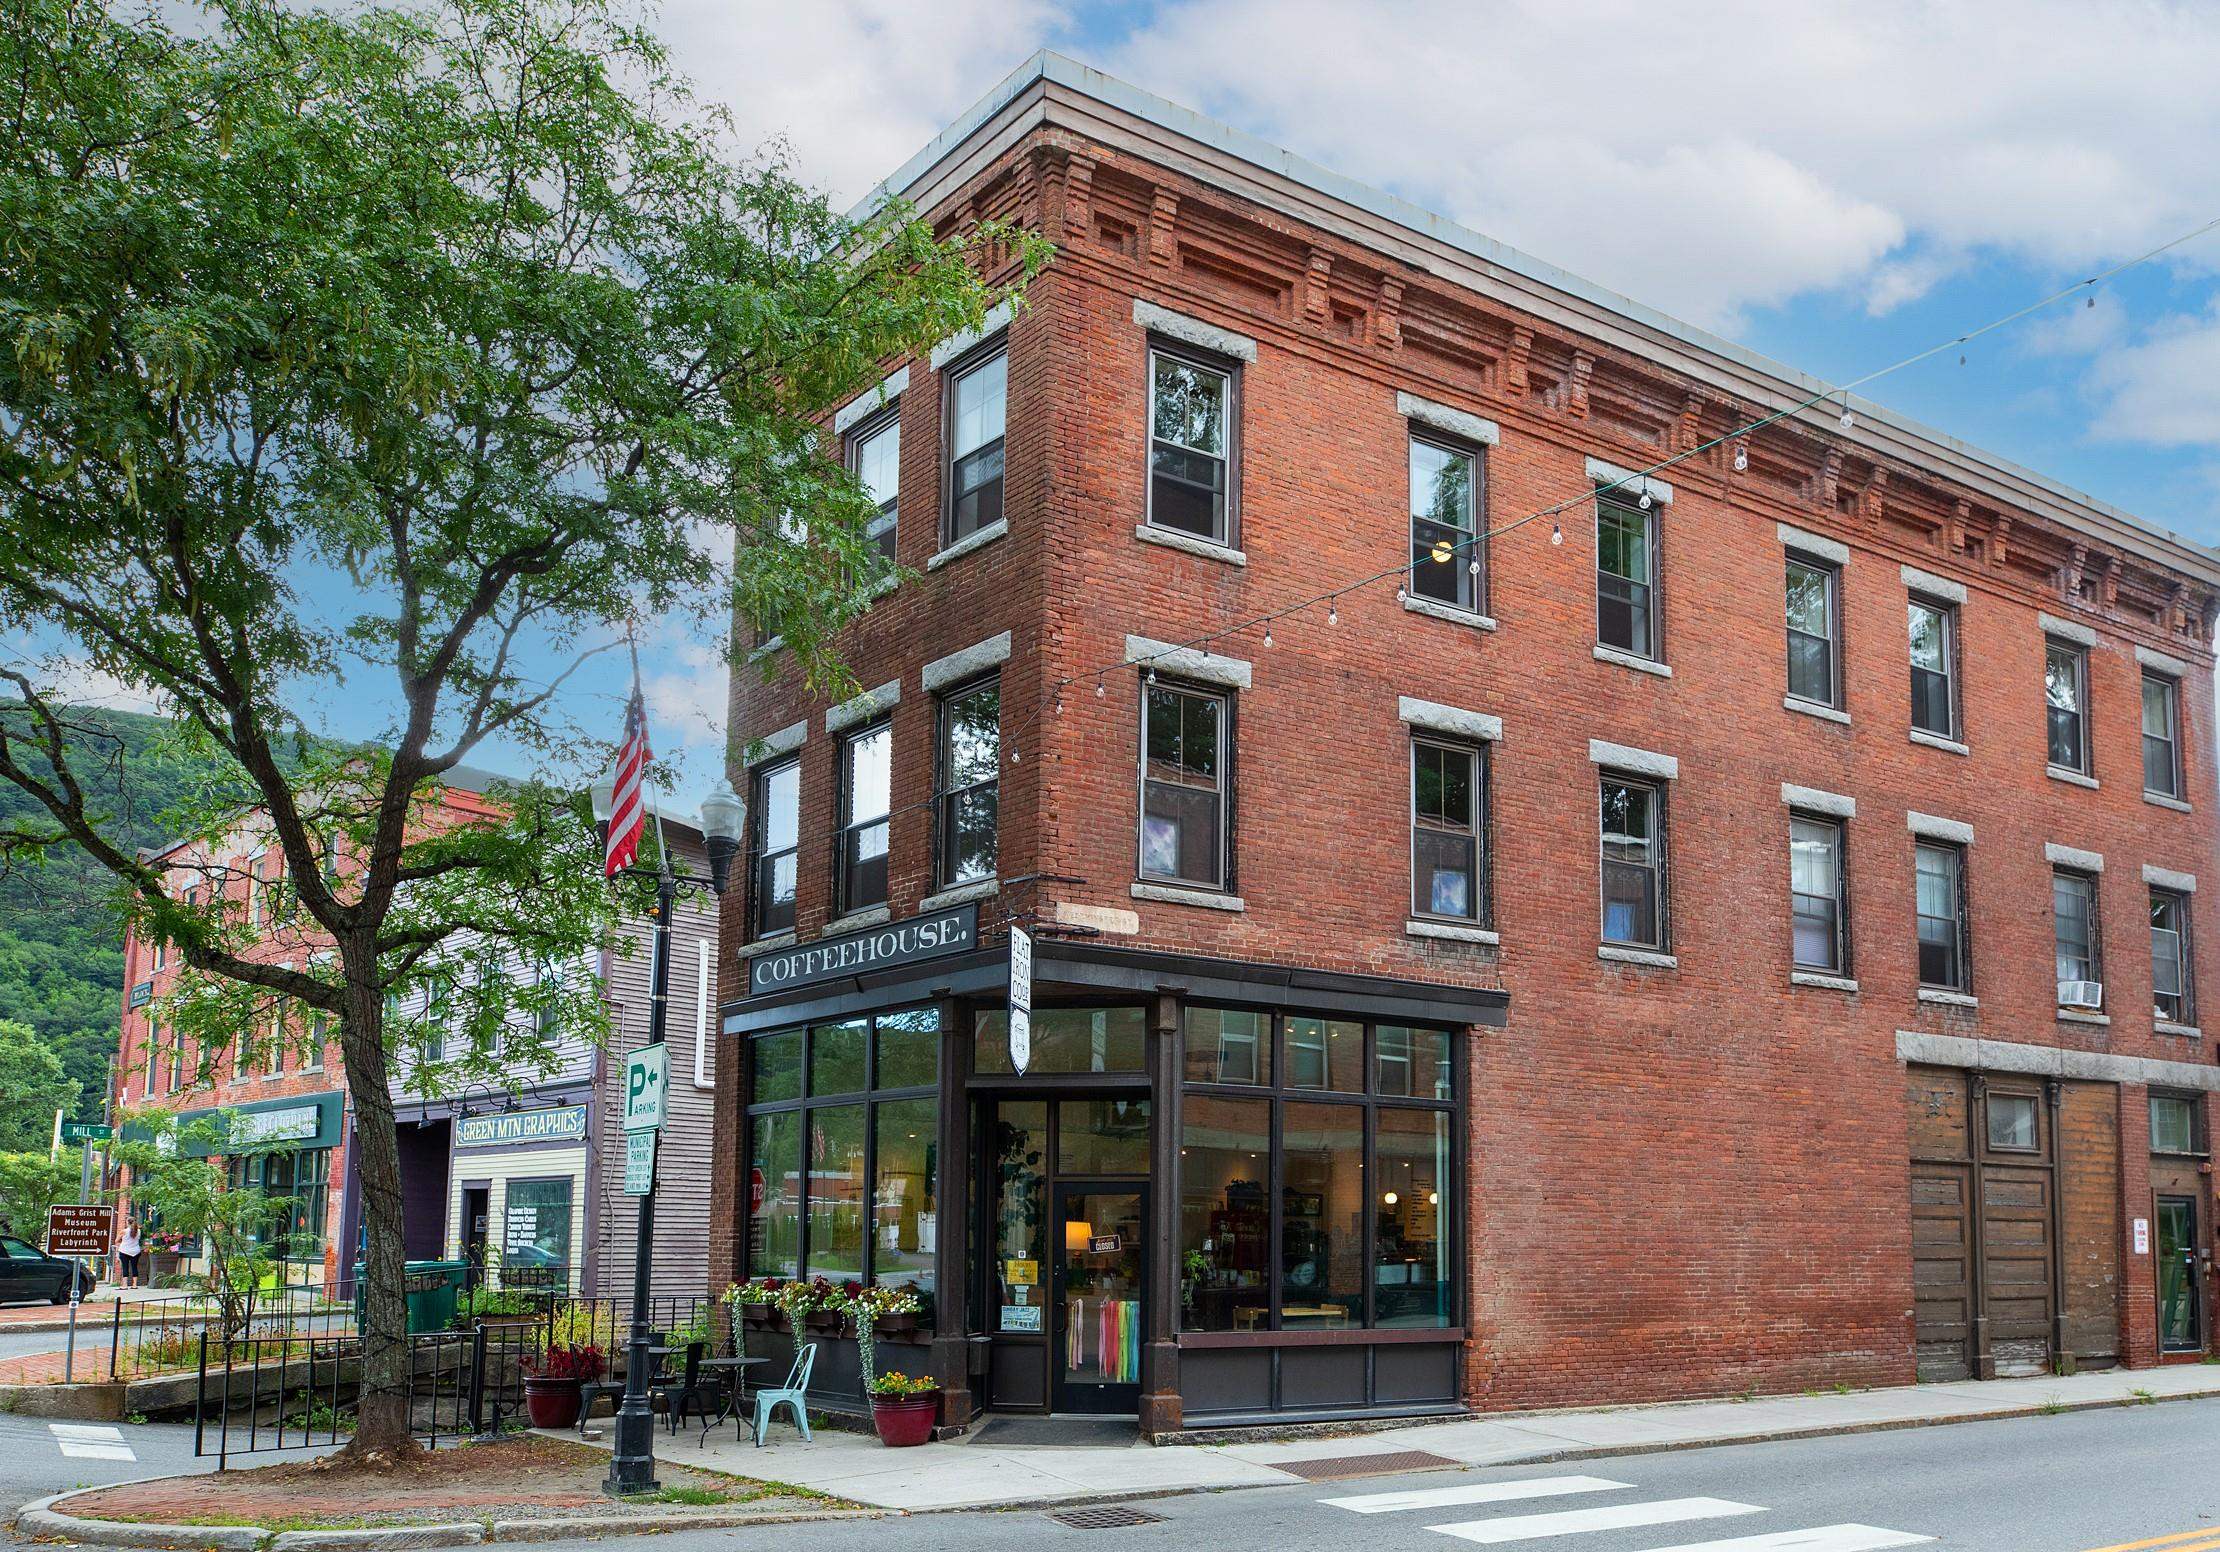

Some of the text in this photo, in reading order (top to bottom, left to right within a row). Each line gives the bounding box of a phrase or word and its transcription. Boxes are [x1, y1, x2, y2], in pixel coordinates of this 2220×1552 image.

[755, 916, 967, 985] COFFEEHOUSE.
[1013, 933, 1029, 960] FLAT
[1013, 956, 1029, 981] IRON
[72, 1126, 92, 1137] MILL
[463, 1111, 578, 1141] GREEN MTN GRAPHICS
[631, 1149, 649, 1161] PARKING
[52, 1208, 111, 1217] Adams Grist Mill
[64, 1218, 97, 1226] Museum
[51, 1228, 108, 1236] Riverfront Park
[60, 1238, 98, 1247] Labyrinth
[1095, 1241, 1115, 1251] CLOSED
